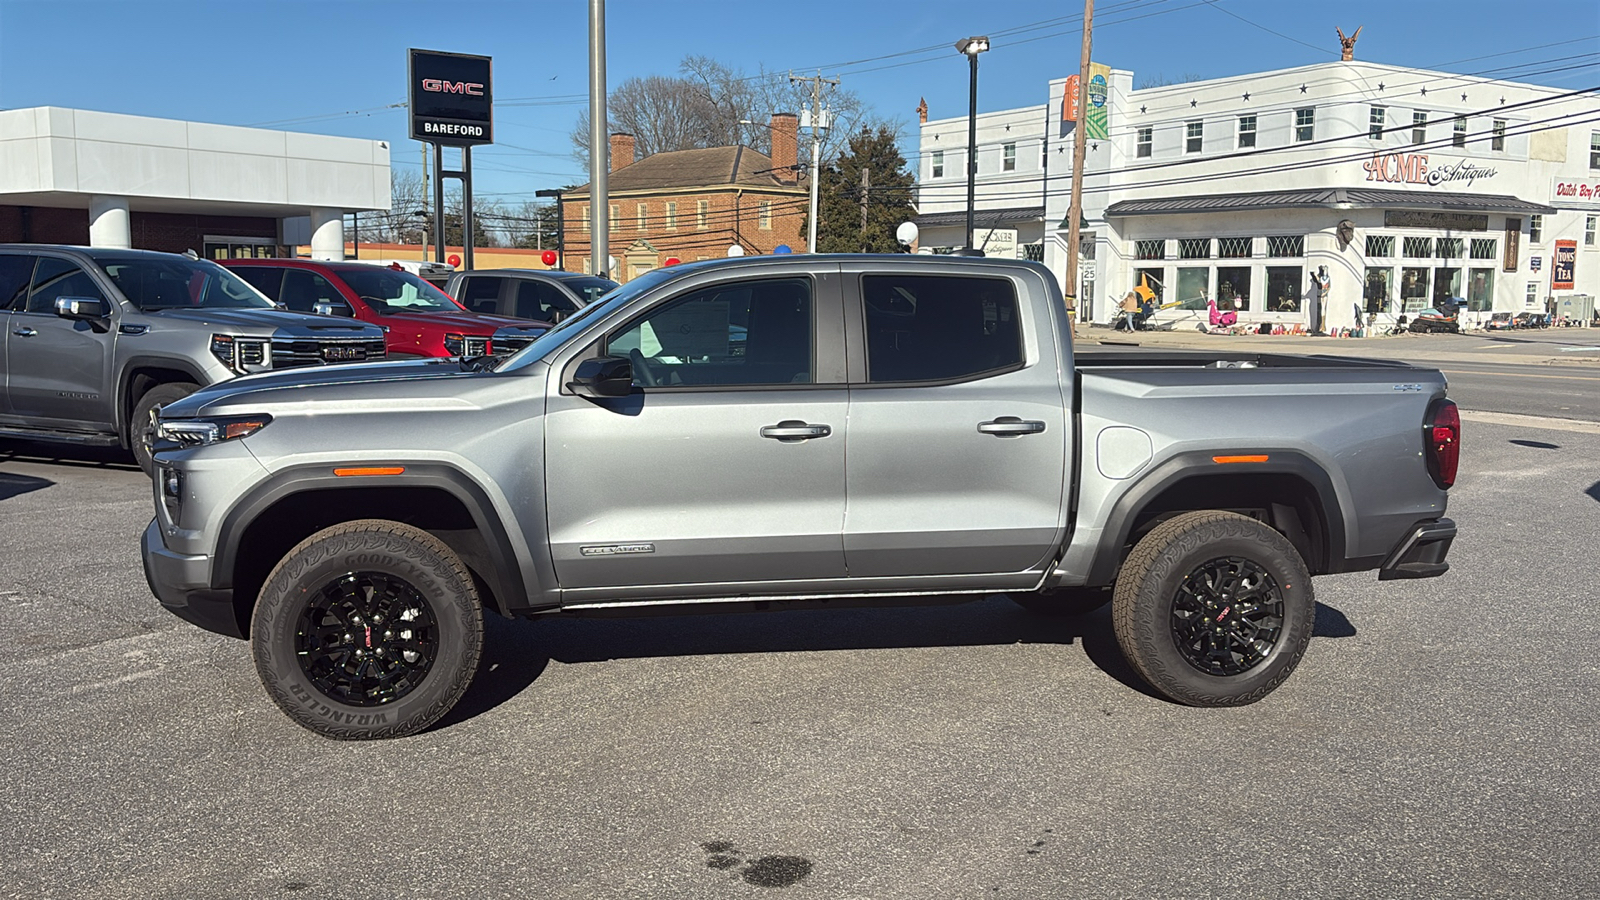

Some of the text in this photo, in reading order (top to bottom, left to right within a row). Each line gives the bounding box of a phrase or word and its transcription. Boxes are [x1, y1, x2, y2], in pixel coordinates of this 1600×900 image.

[422, 79, 484, 96] GMC
[424, 122, 483, 136] BAREFORD
[1363, 152, 1498, 187] ACME Antiques
[1557, 183, 1577, 196] Dutch
[1579, 184, 1594, 200] Boy
[1084, 270, 1095, 278] 25
[1557, 267, 1572, 280] TEA
[324, 347, 366, 359] GMC
[583, 544, 650, 554] ELEVATION
[344, 553, 444, 598] GOODYEAR
[1216, 606, 1231, 622] GMC
[289, 682, 388, 726] WRANGLER
